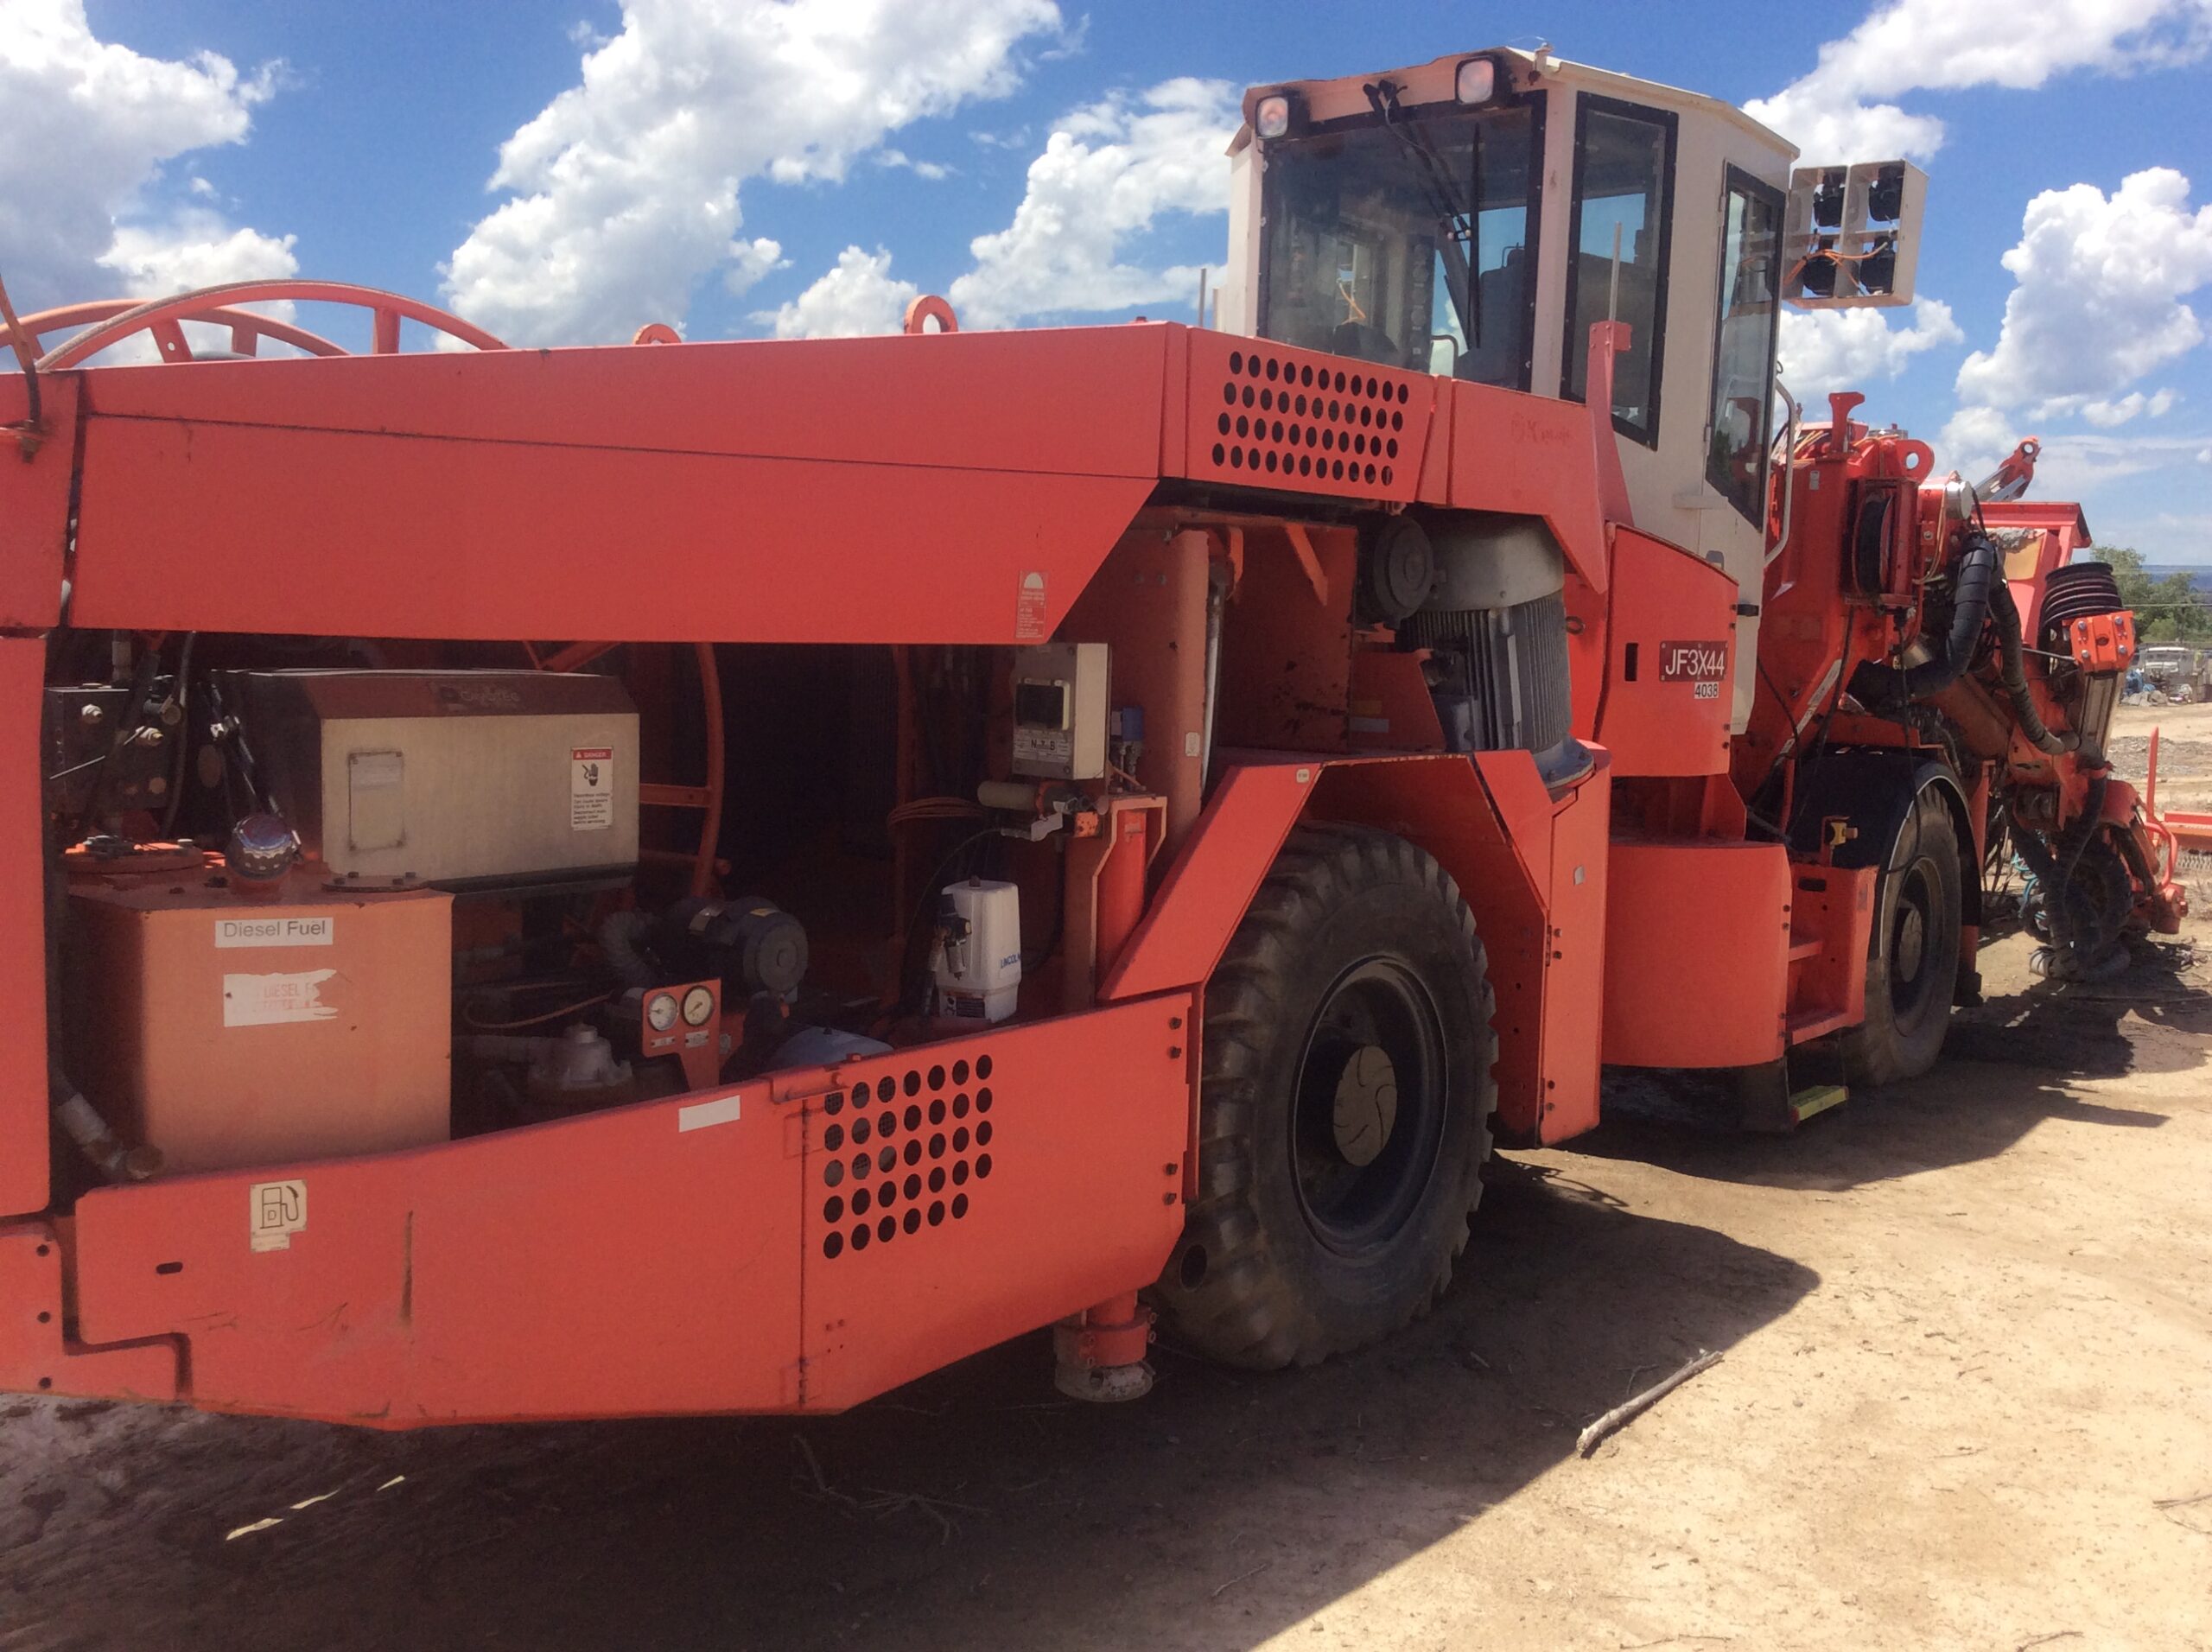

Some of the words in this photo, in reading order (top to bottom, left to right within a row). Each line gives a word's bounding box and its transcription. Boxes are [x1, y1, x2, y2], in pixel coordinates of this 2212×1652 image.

[1665, 649, 1725, 676] JF3X44
[1695, 683, 1719, 697] 4038
[224, 921, 280, 937] Diesel
[287, 920, 326, 935] Fuel
[268, 1210, 276, 1221] D
